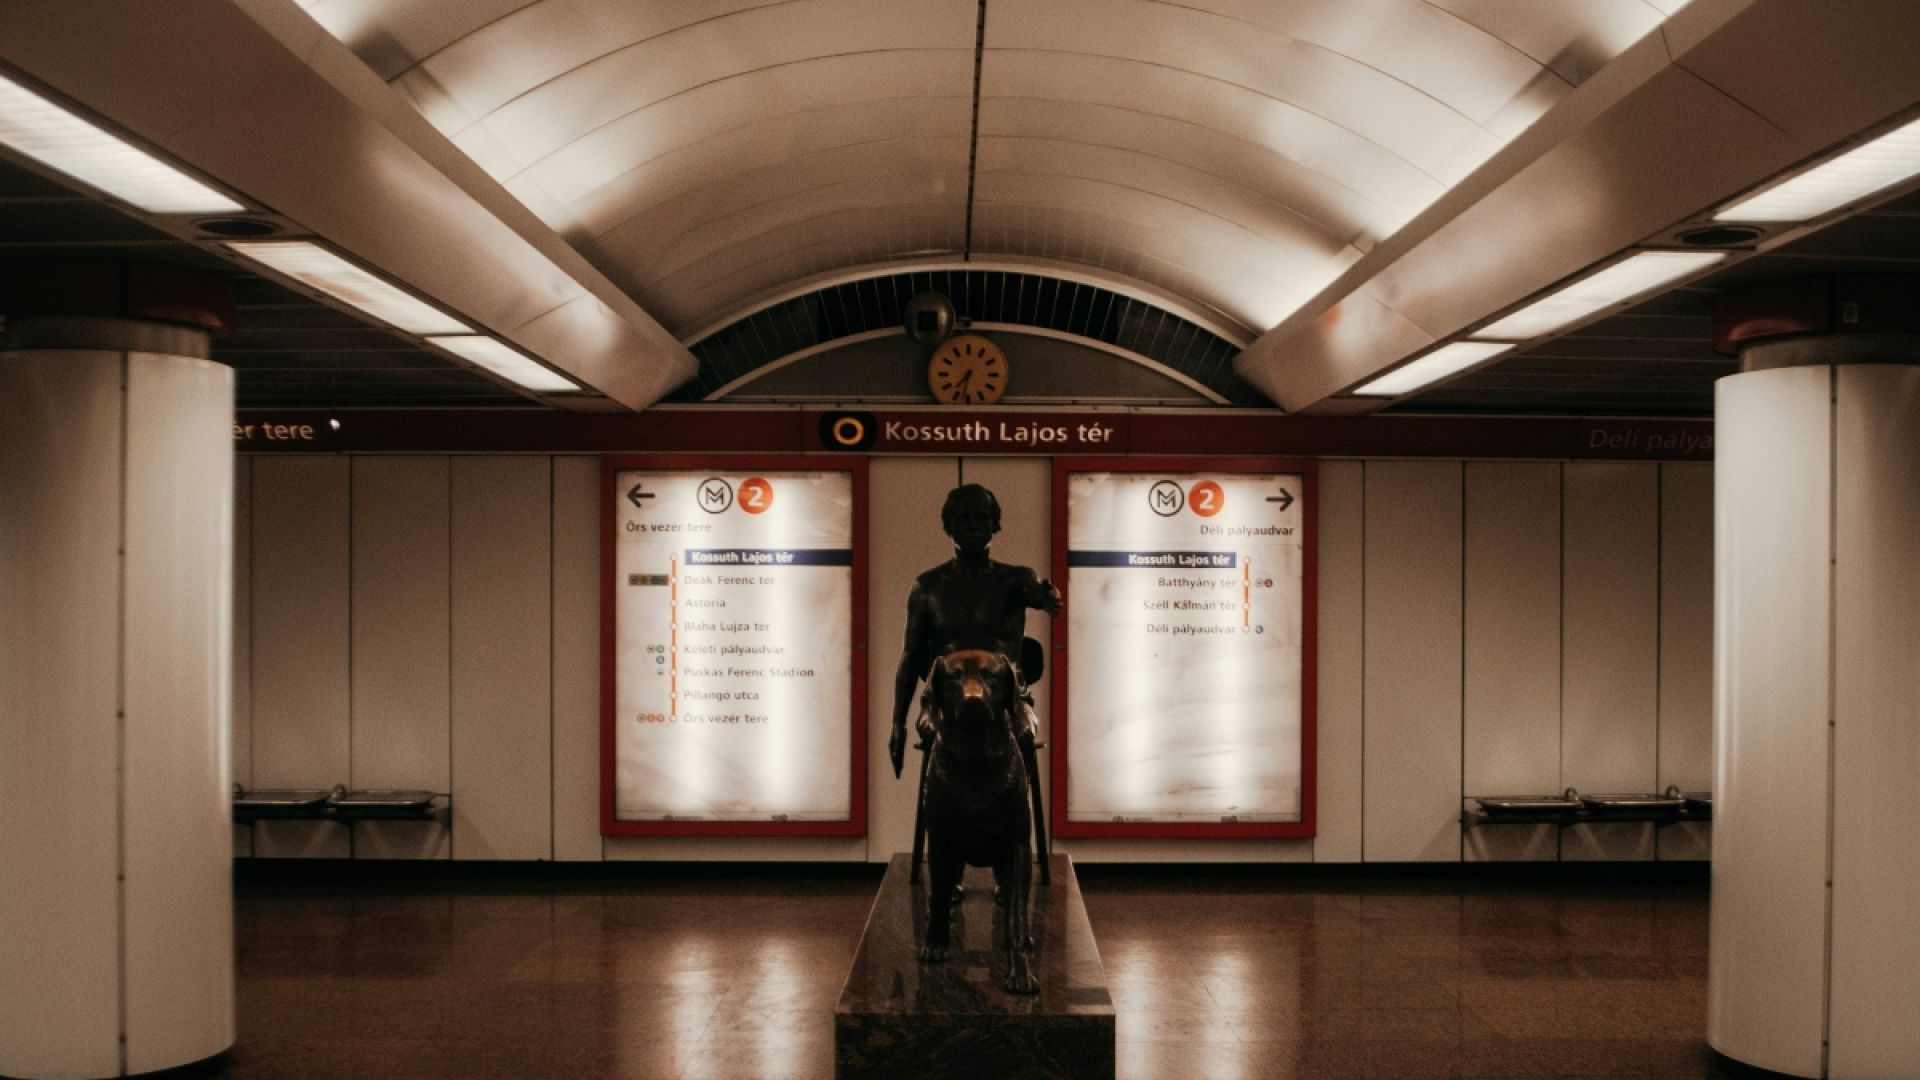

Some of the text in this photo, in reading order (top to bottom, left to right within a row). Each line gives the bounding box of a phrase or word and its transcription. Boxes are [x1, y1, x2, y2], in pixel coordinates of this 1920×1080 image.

[261, 421, 315, 440] tere
[885, 421, 1114, 447] Kossuth Lajos tér
[1645, 428, 1714, 454] pálya
[747, 486, 764, 507] 2
[1198, 488, 1216, 510] 2
[650, 521, 682, 533] vezér
[687, 522, 712, 533] tere
[1199, 525, 1295, 539] Déli pályaudvar
[691, 551, 795, 565] Kossuth Lajos tér
[1128, 553, 1232, 567] Kossuth Lajos tér
[684, 574, 775, 586] Deák Ferenc tér
[1157, 577, 1237, 590] Batthyány tér
[684, 598, 727, 609] Astoria
[1219, 600, 1237, 611] tér
[684, 621, 771, 635] Blaha Lujza tér
[1146, 623, 1237, 636] Déli pályaudvar
[684, 643, 785, 657] Keleti pályaudvar
[727, 667, 765, 678] Ferenc
[768, 667, 815, 678] Stadion
[684, 690, 760, 703] Pillangó utca
[707, 712, 742, 724] vezér
[744, 714, 769, 724] tere
